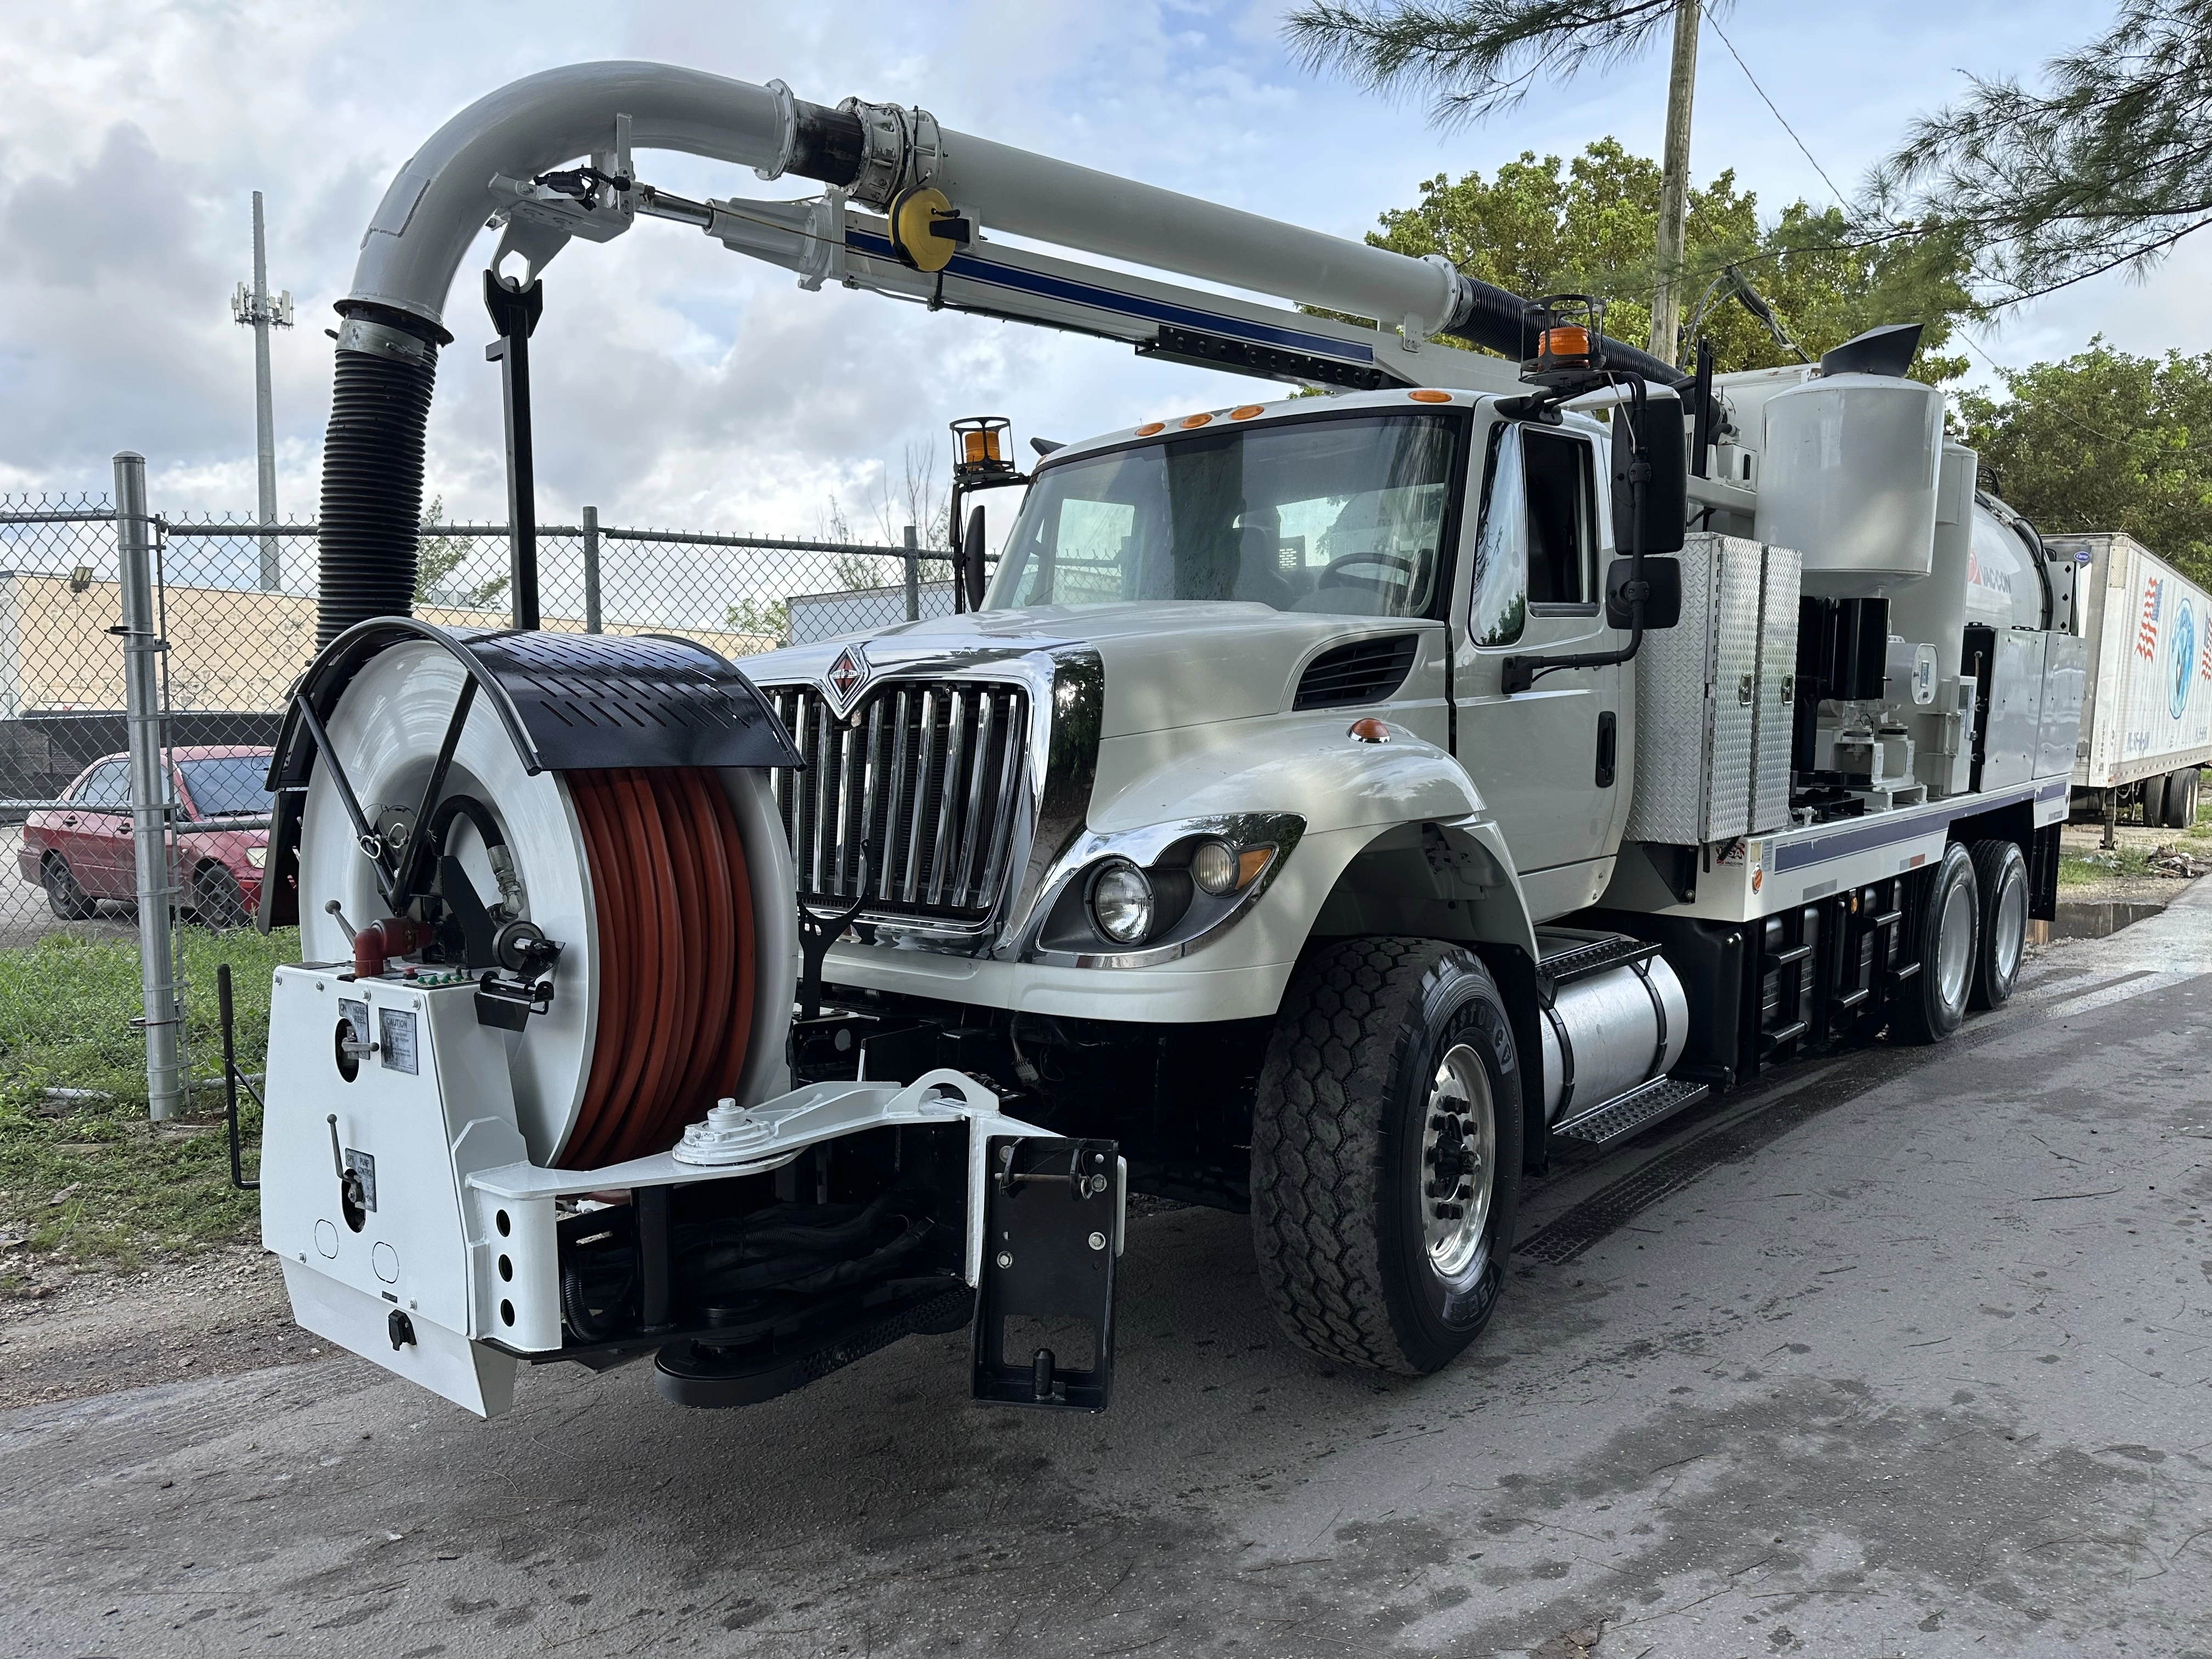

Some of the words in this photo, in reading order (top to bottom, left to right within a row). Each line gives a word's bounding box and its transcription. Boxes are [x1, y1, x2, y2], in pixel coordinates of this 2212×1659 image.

[353, 1005, 365, 1015] HOSE
[354, 1015, 366, 1025] REEL
[386, 1017, 408, 1029] CAUTION
